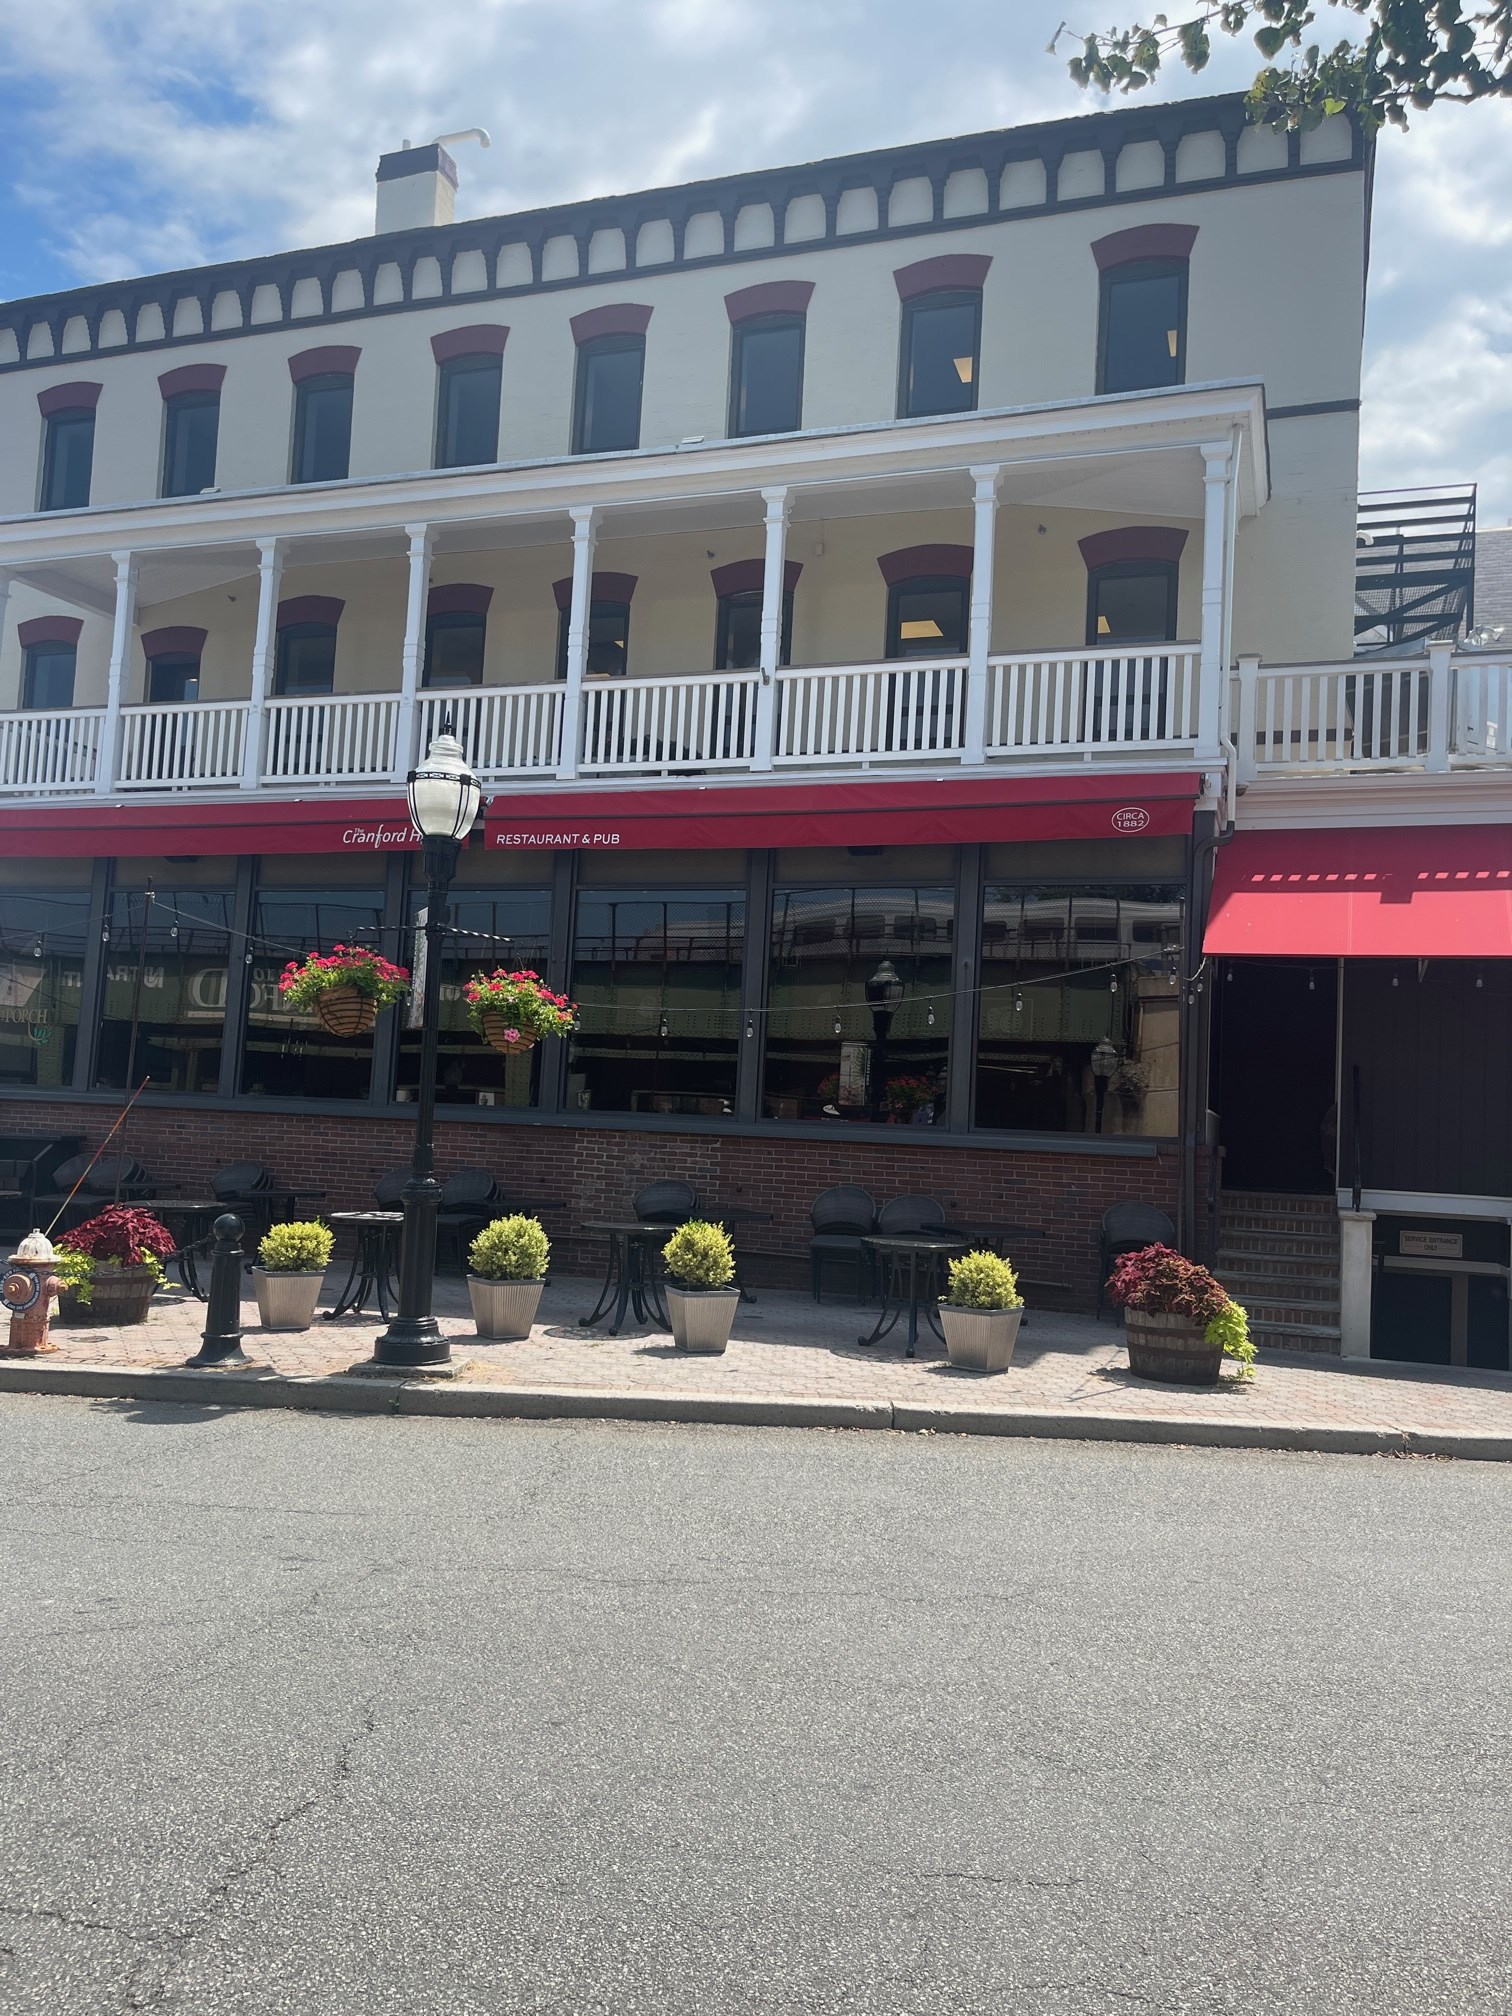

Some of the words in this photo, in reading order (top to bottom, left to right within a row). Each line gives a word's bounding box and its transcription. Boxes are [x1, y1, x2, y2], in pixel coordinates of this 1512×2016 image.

[1117, 812, 1144, 820] CIRCA
[343, 824, 407, 848] Cranford
[496, 834, 580, 845] RESTAURANT
[582, 833, 591, 844] &
[593, 833, 620, 844] PUB
[4, 1008, 48, 1024] PORCH
[1429, 1237, 1457, 1245] ENTRANCE
